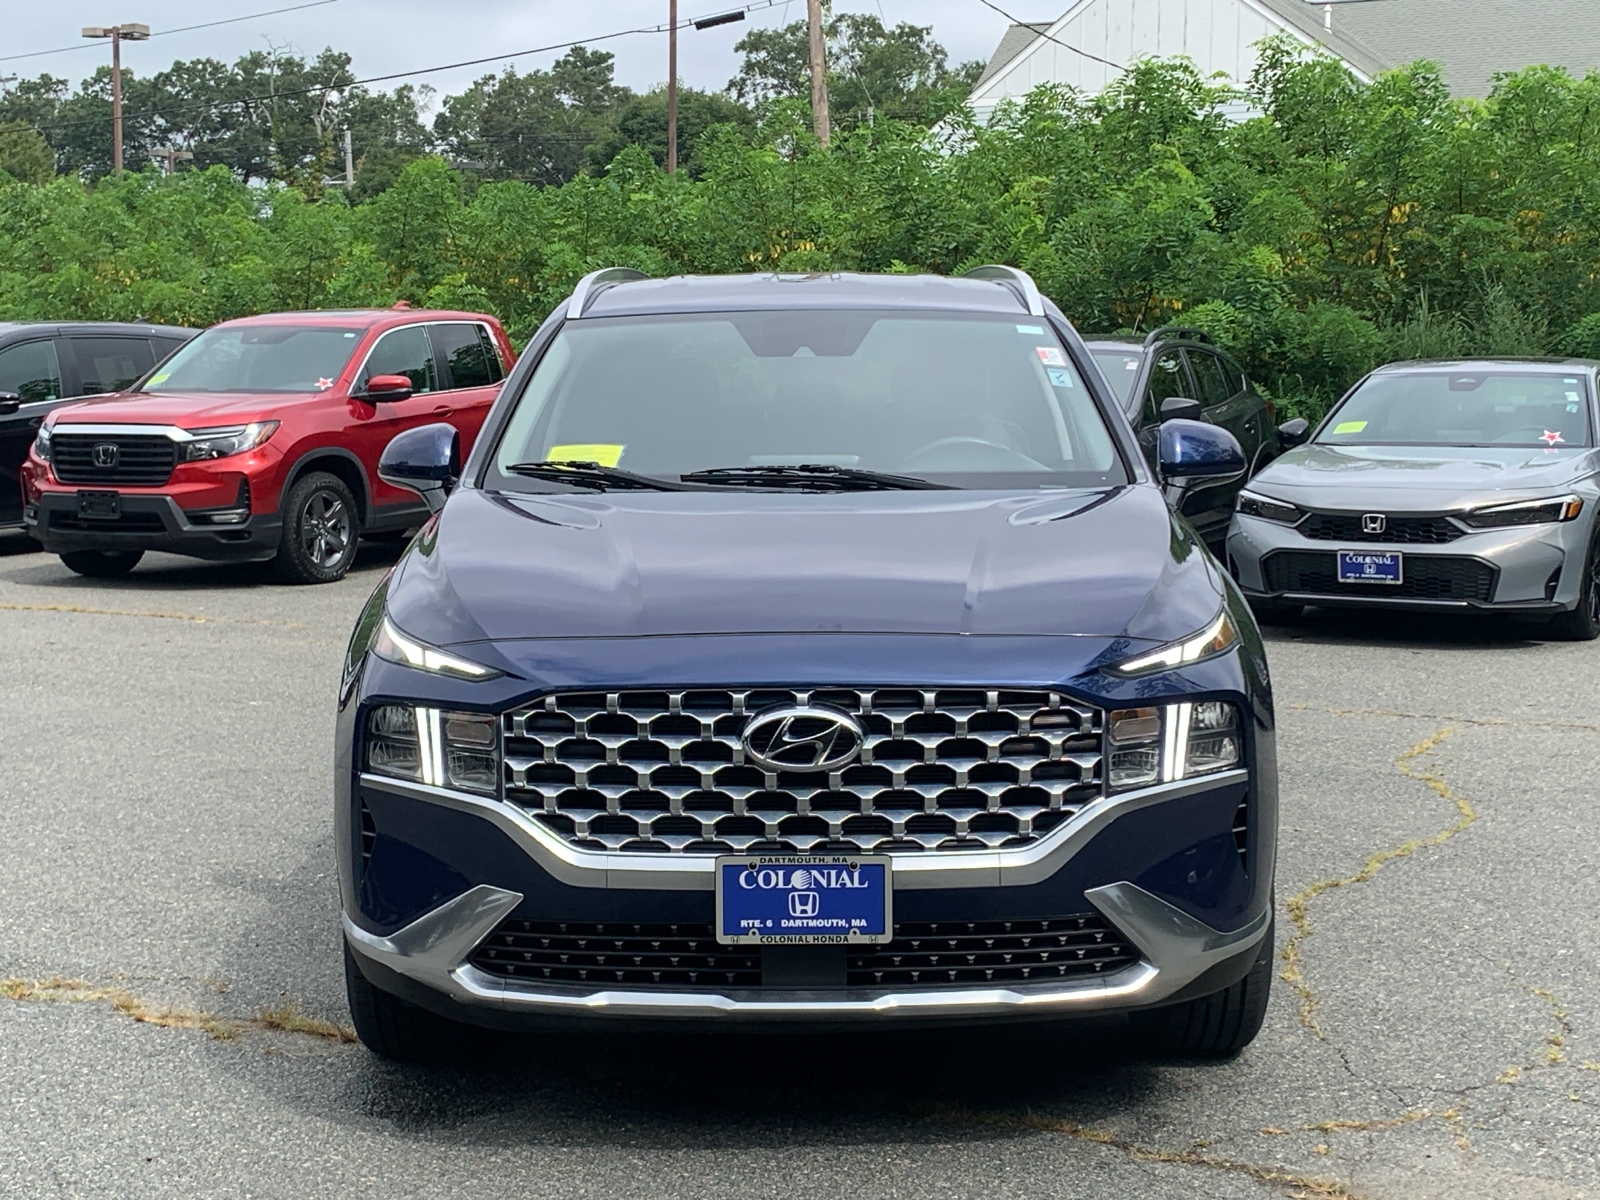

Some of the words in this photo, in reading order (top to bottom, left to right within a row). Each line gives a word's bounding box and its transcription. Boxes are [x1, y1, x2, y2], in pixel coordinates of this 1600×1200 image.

[1345, 555, 1394, 564] COLONIAL
[739, 869, 868, 890] COLONIAL
[740, 919, 764, 928] RTE.
[766, 919, 773, 928] 6
[780, 919, 849, 929] DARTMOUTH,
[851, 918, 867, 927] MA
[760, 935, 809, 944] COLONIAL
[812, 935, 849, 943] HONDA
